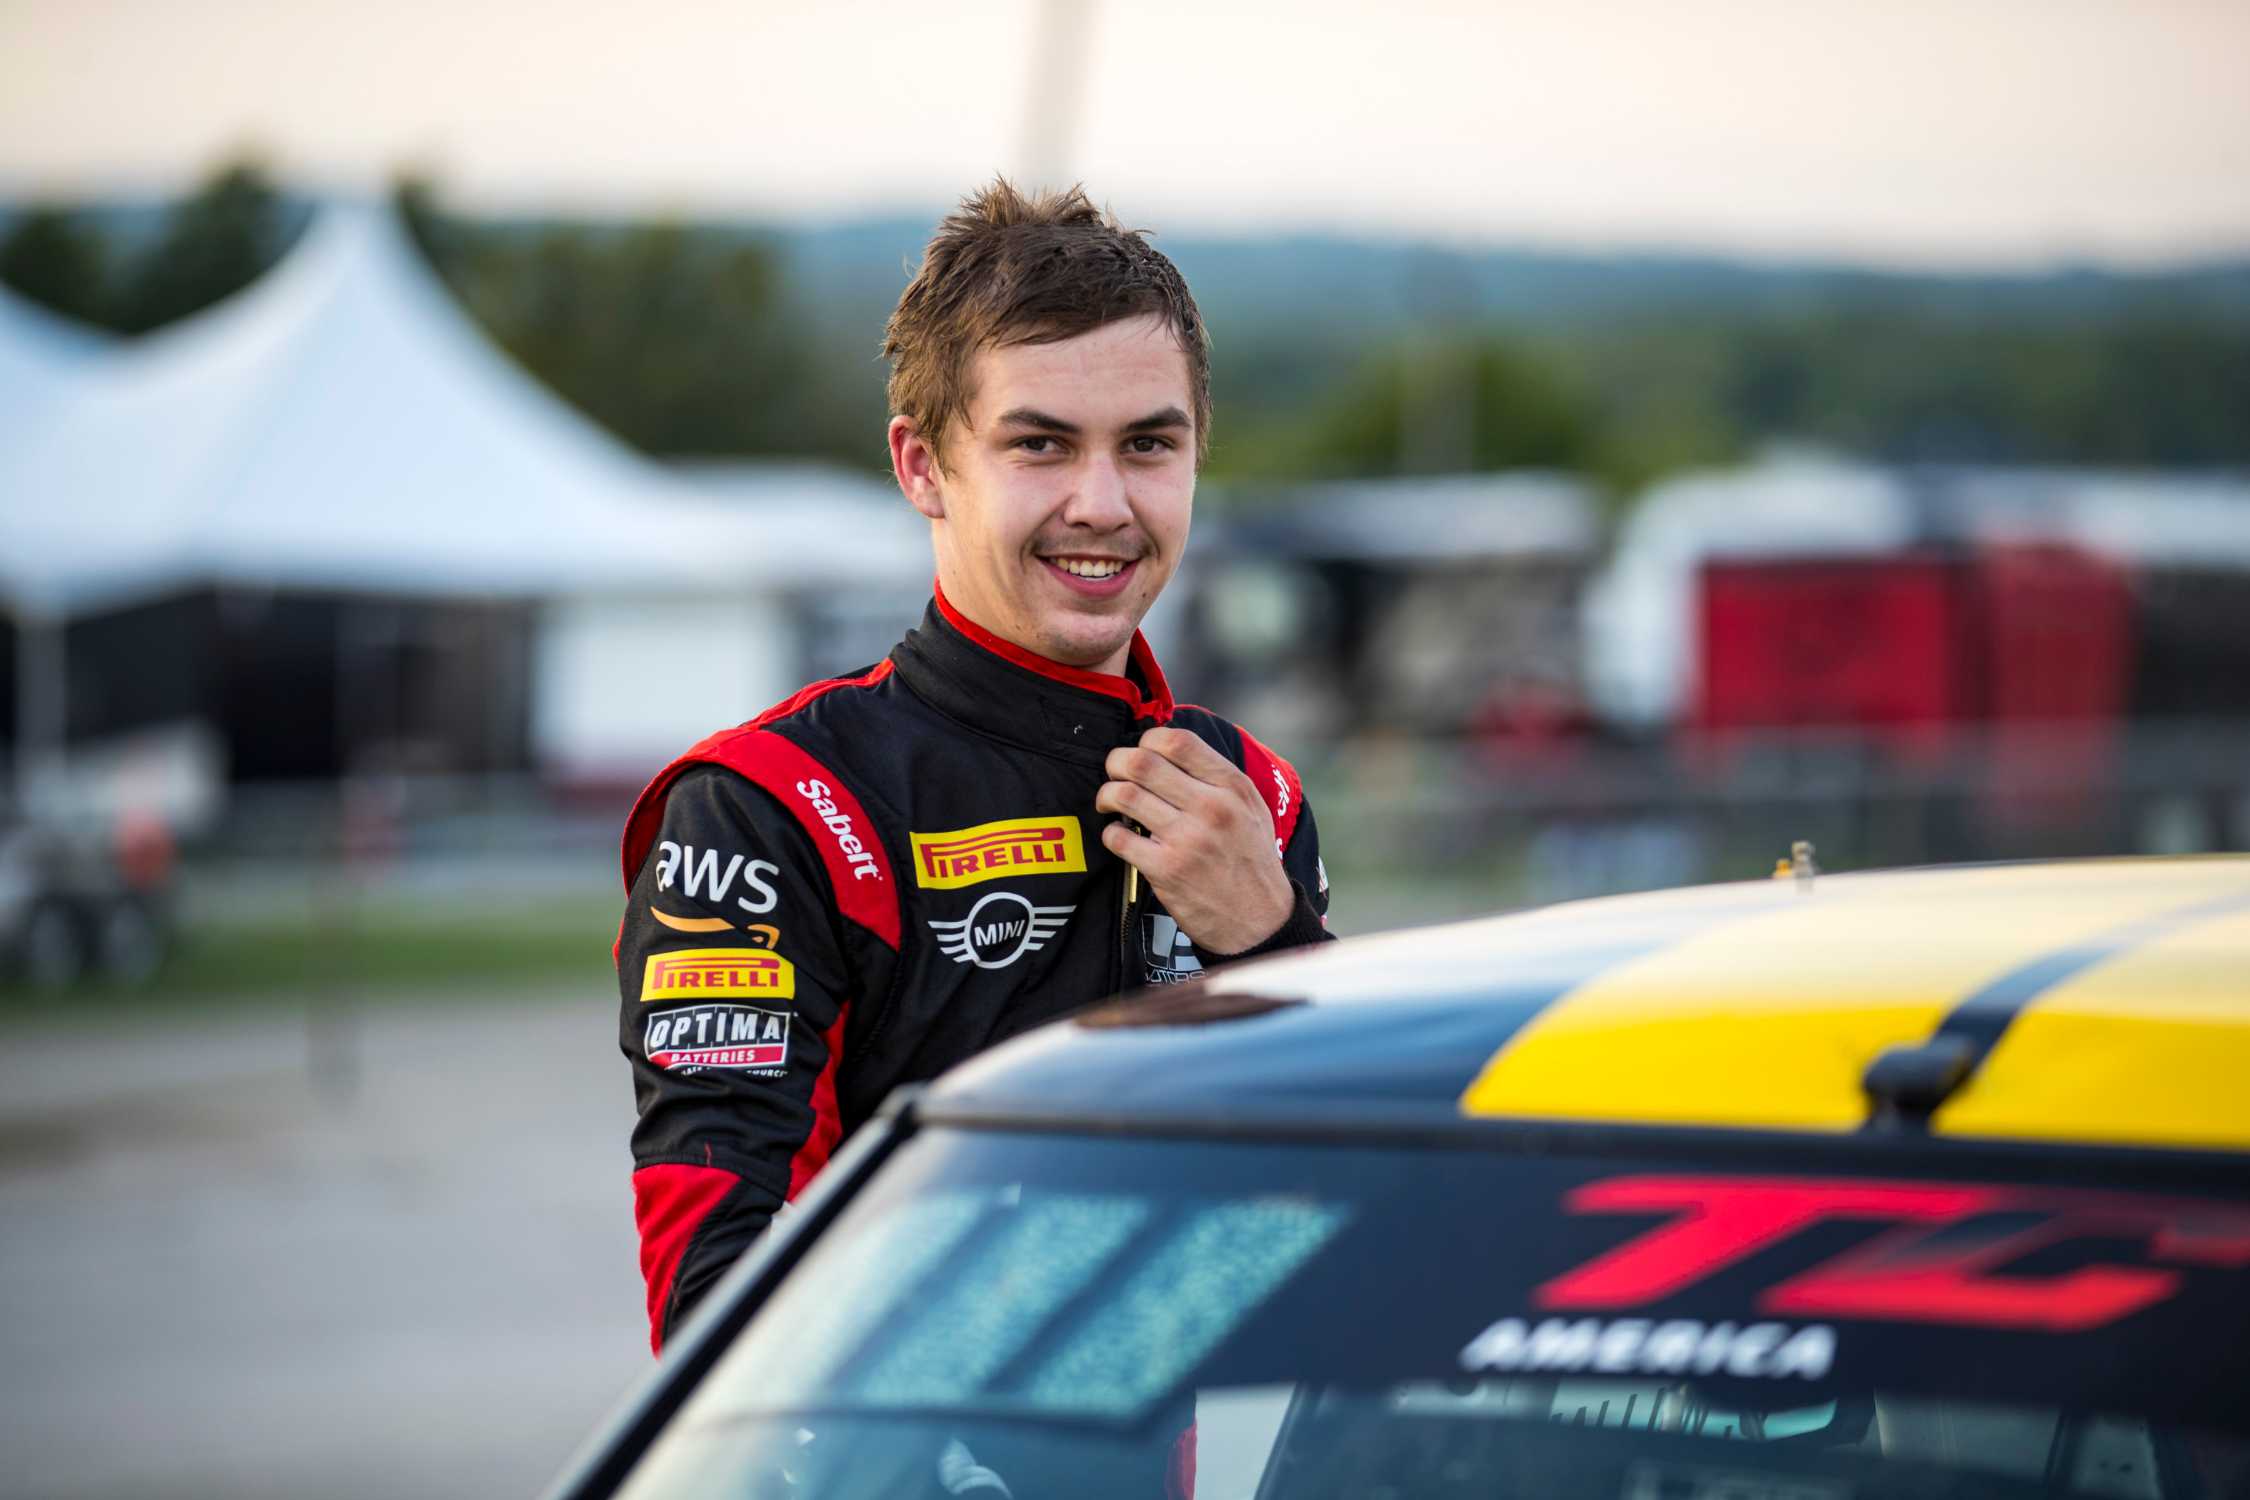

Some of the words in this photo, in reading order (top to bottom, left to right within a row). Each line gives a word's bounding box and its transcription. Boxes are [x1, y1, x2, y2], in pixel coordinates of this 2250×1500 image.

[796, 778, 881, 881] Sabelt
[919, 827, 1066, 879] PIRELLI
[655, 841, 780, 914] aws
[974, 919, 1026, 947] MINI
[652, 957, 781, 990] PIRELLI
[650, 1012, 781, 1049] OPTIMA
[670, 1050, 756, 1064] BATTERIES
[1458, 1316, 1838, 1381] AMERICA
